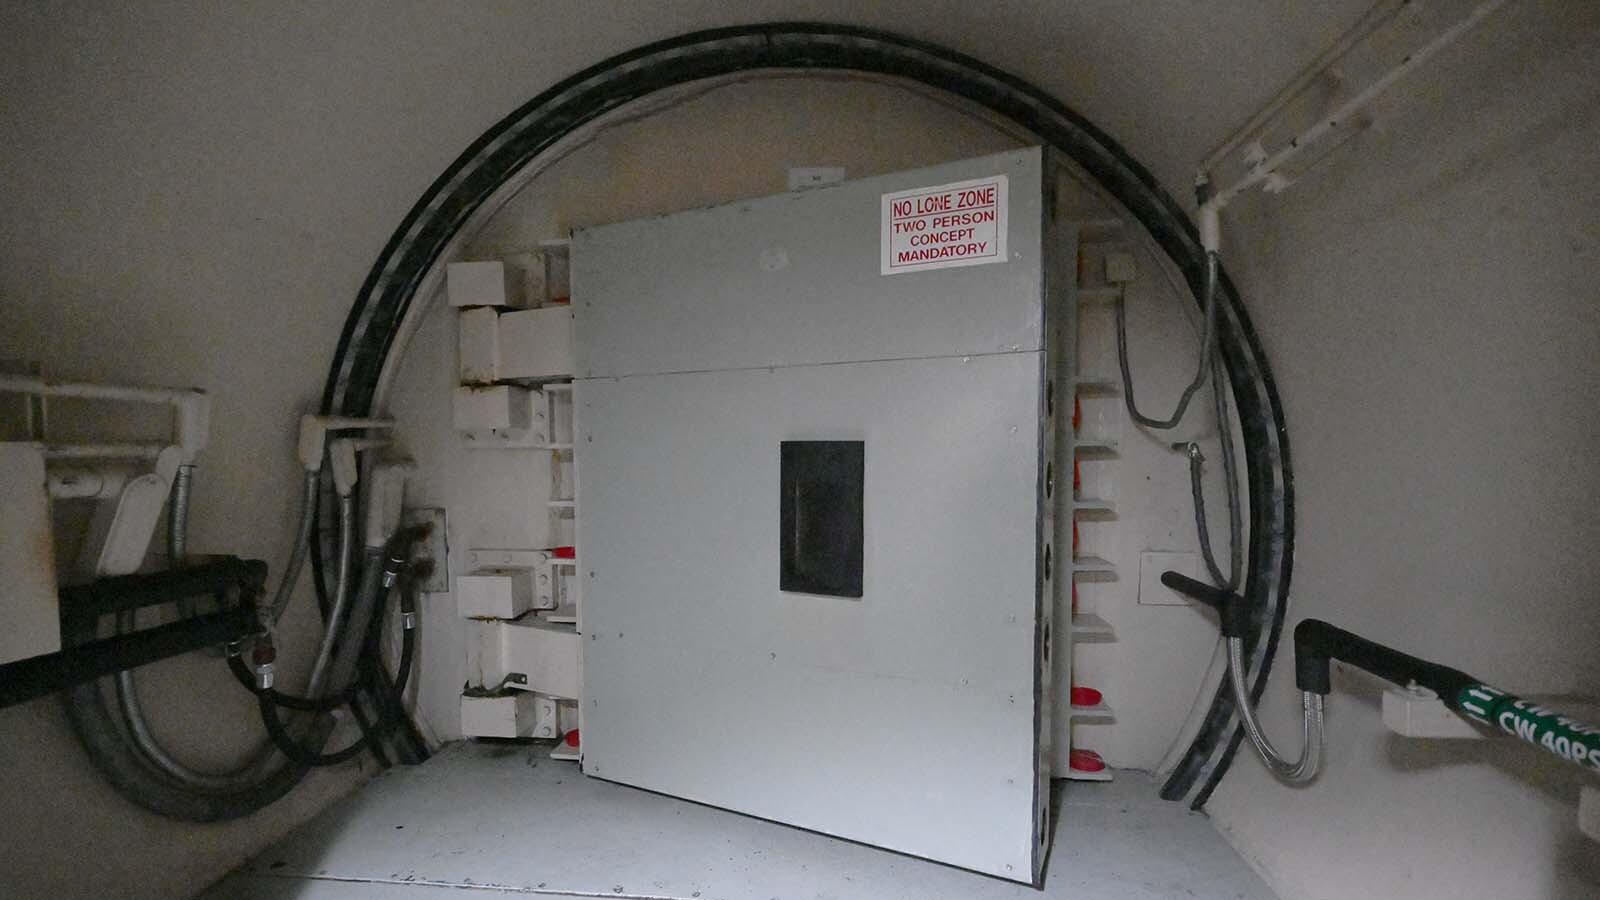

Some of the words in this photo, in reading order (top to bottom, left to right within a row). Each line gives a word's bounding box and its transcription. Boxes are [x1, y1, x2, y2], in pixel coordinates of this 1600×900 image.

[893, 200, 912, 217] NO
[917, 194, 951, 214] LONE
[957, 188, 995, 208] ZONE
[893, 220, 926, 234] TWO
[932, 210, 994, 229] PERSON
[910, 228, 975, 246] CONCEPT
[898, 241, 987, 262] MANDATORY
[1499, 711, 1537, 744] CW
